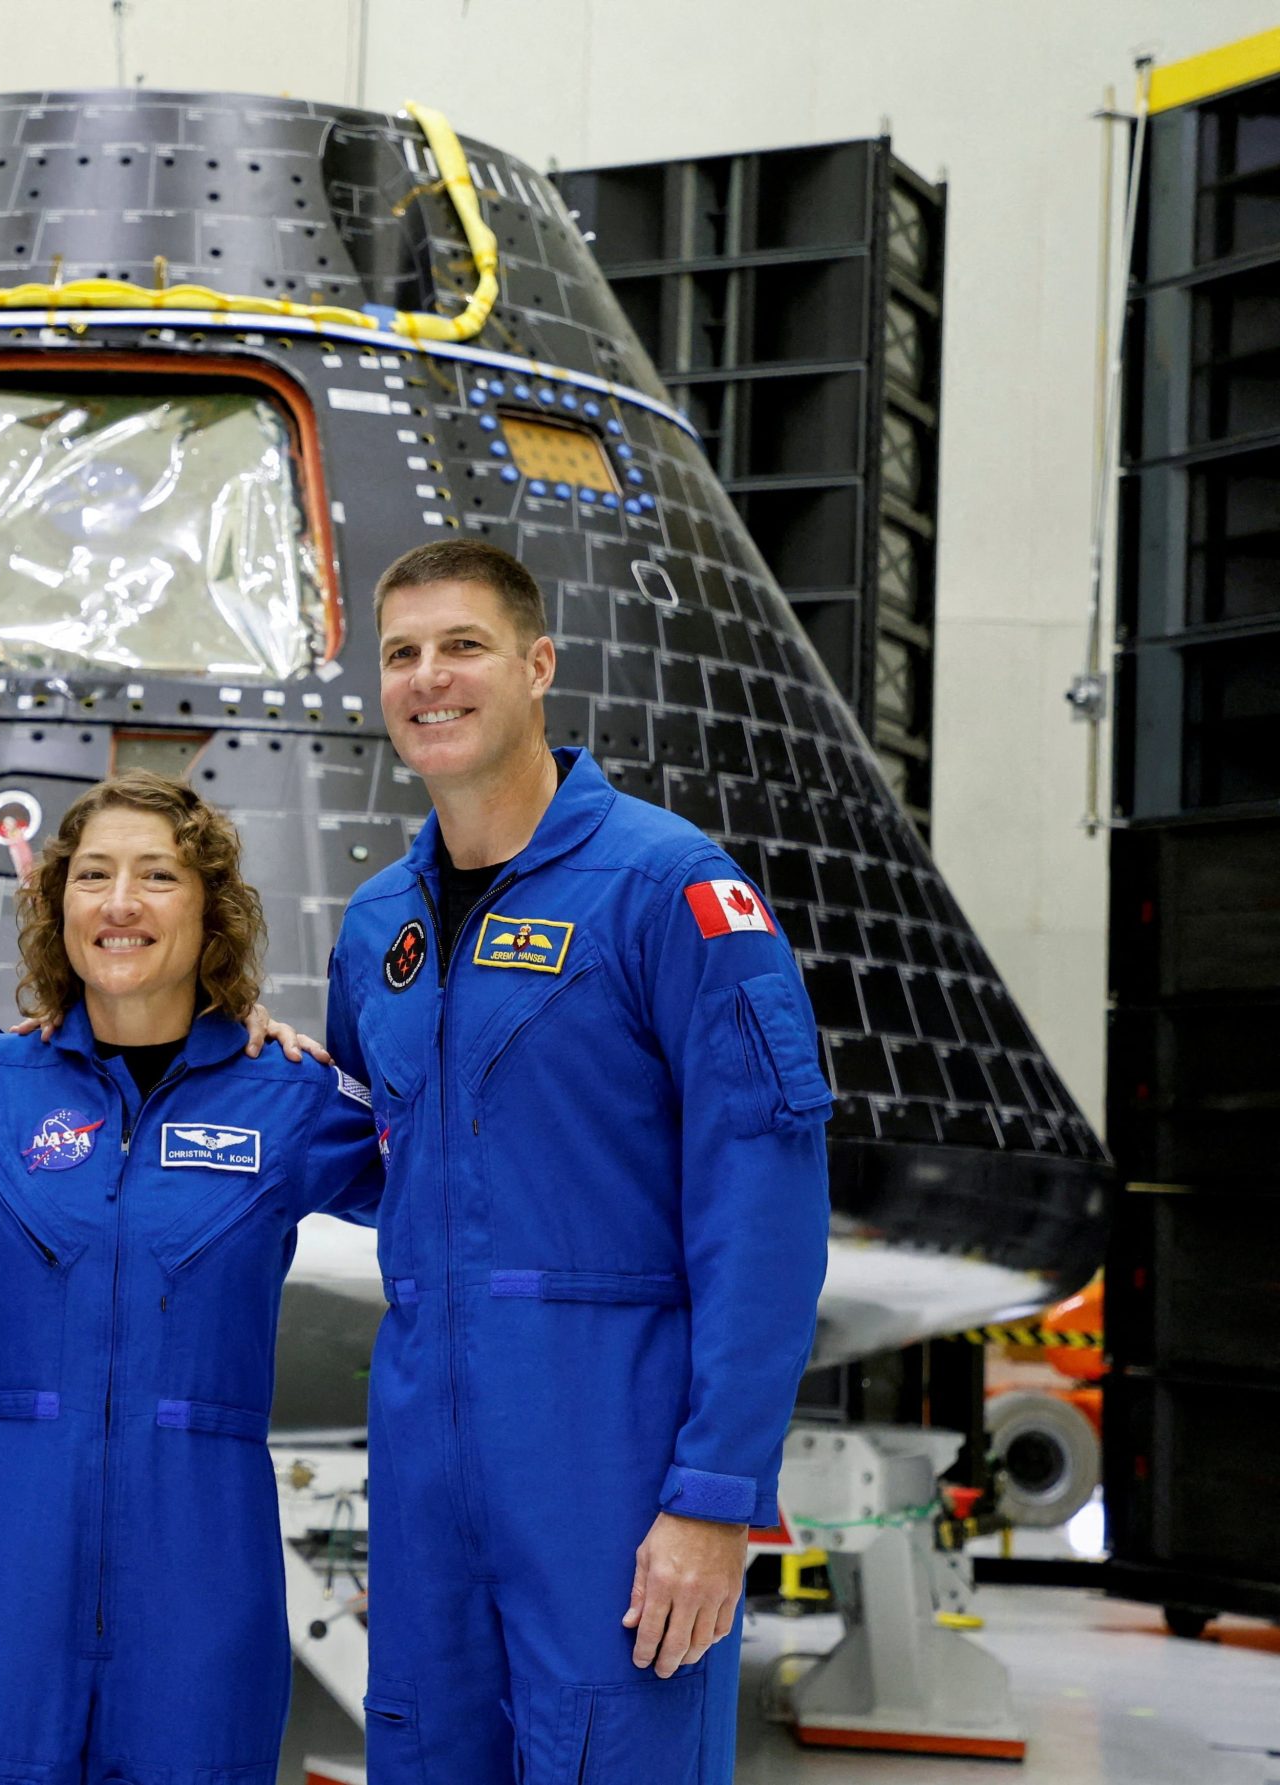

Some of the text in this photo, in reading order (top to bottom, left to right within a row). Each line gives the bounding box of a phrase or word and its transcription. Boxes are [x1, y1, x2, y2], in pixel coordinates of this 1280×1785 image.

[491, 951, 547, 964] JEREMY HANSEN
[32, 1131, 91, 1149] NASA
[168, 1149, 254, 1164] CHRISTINA H. KOCH
